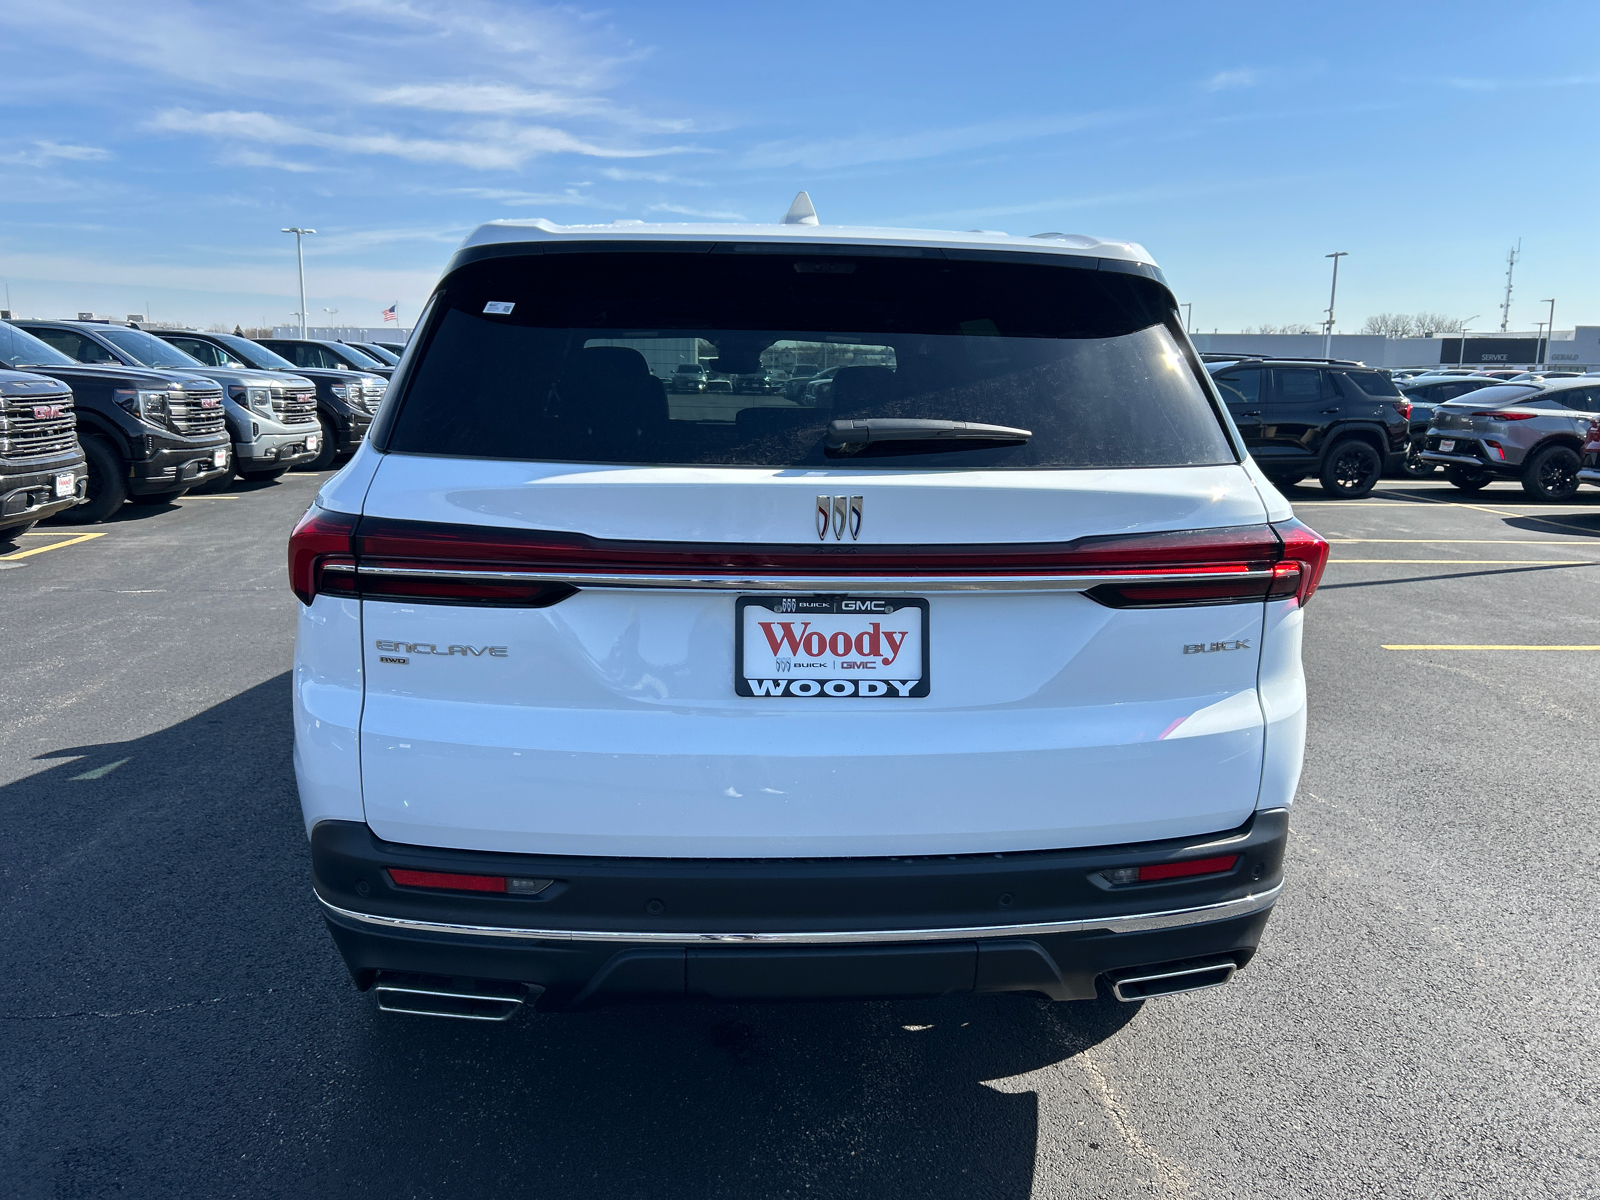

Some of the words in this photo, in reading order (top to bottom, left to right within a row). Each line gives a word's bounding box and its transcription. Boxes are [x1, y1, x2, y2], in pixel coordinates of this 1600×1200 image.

[1481, 353, 1509, 361] SERVICE
[1551, 353, 1580, 361] GERALD
[33, 404, 65, 420] GMC
[841, 600, 885, 611] GMC
[375, 639, 509, 657] ENCLAVE
[757, 621, 908, 666] Woody
[1183, 638, 1251, 655] BUICK
[840, 661, 876, 669] GMC
[747, 679, 919, 696] WOODY
